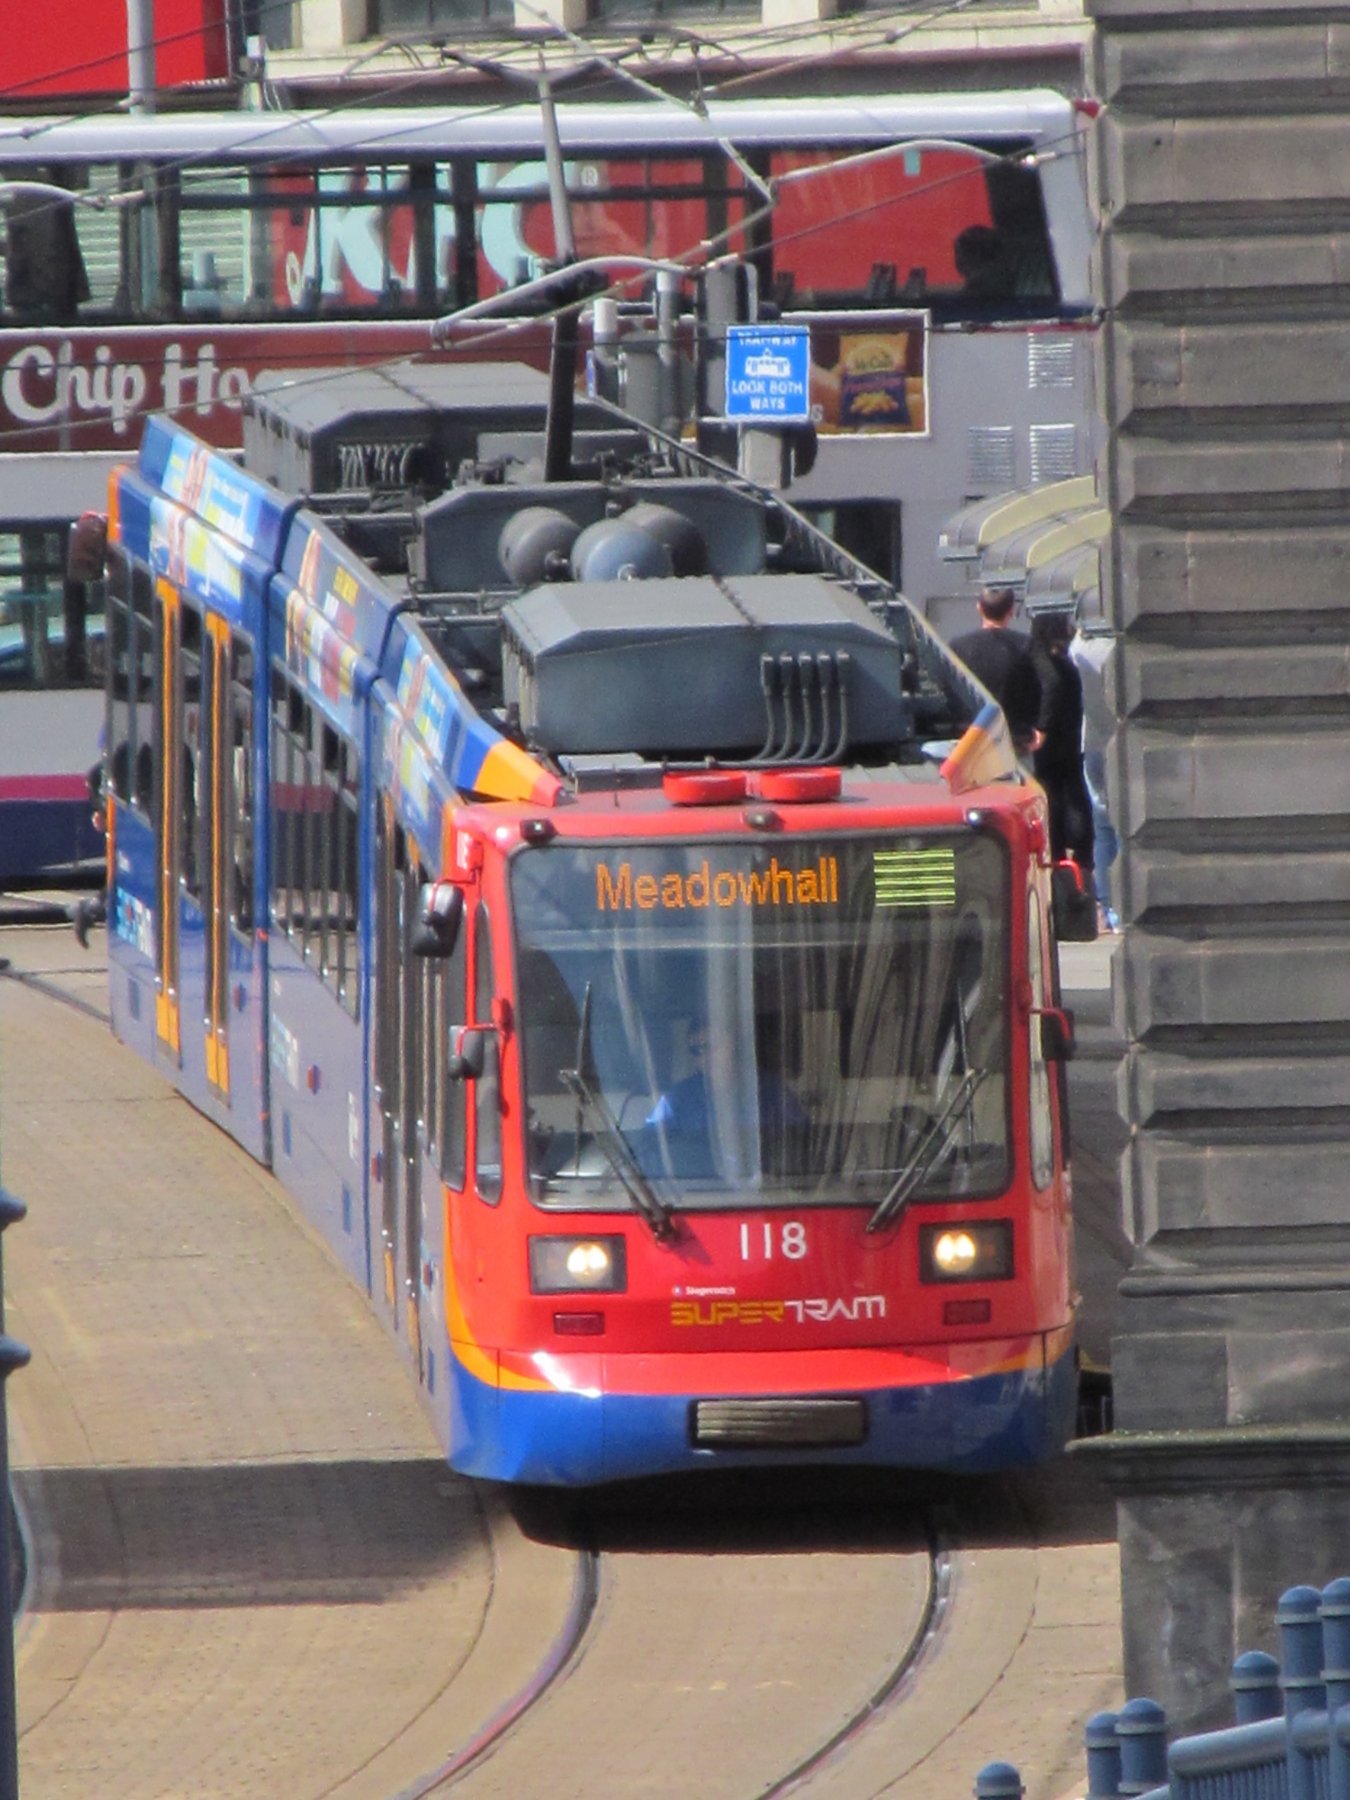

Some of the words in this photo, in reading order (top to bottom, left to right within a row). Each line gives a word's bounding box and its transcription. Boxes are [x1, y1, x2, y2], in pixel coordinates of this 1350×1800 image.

[2, 339, 147, 435] Chip
[732, 379, 766, 396] LOOK
[769, 380, 803, 396] BOTH
[750, 396, 786, 411] WAYS
[595, 855, 839, 911] Meadowhall
[739, 1222, 808, 1261] 118
[671, 1296, 887, 1326] SUPERTRAM
